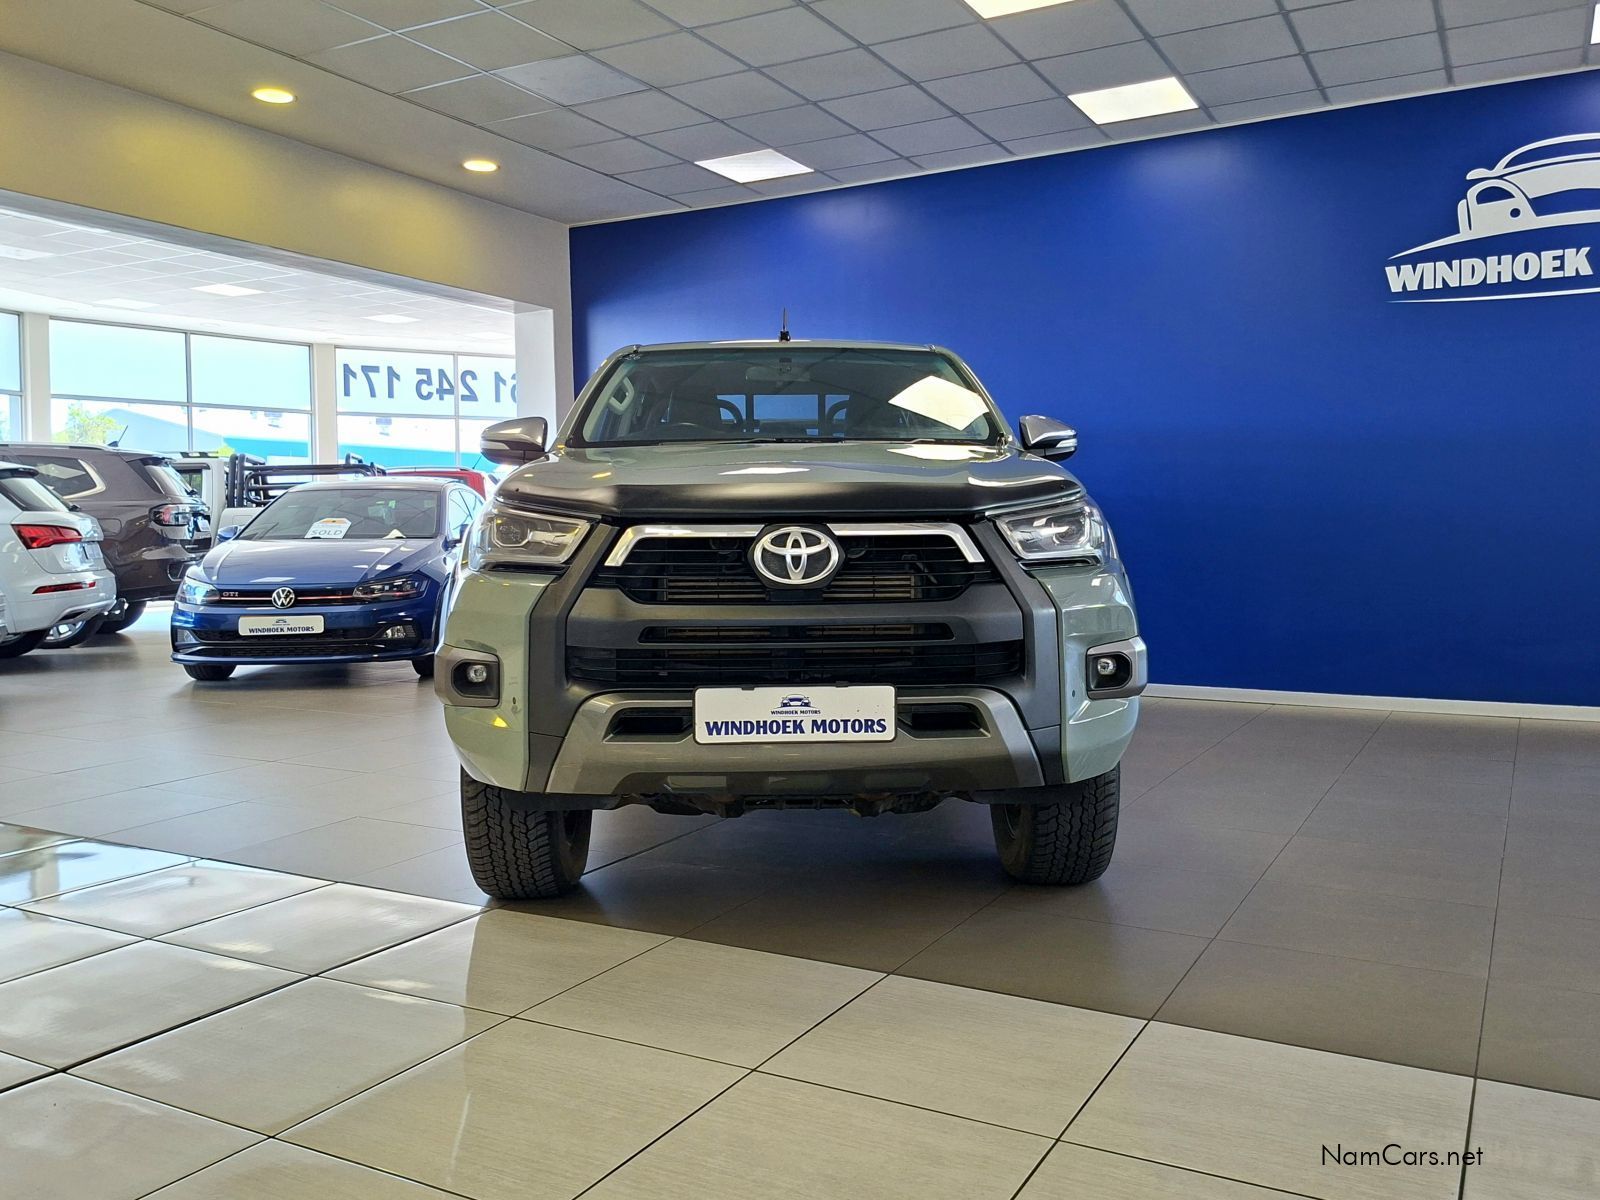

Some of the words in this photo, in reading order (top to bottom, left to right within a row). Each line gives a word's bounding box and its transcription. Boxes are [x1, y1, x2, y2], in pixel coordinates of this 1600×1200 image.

[1385, 247, 1593, 292] WINDHOEK
[248, 626, 285, 634] WINDHOEK
[286, 625, 315, 633] MOTORS
[704, 719, 805, 736] WINDHOEK
[811, 718, 887, 734] MOTORS
